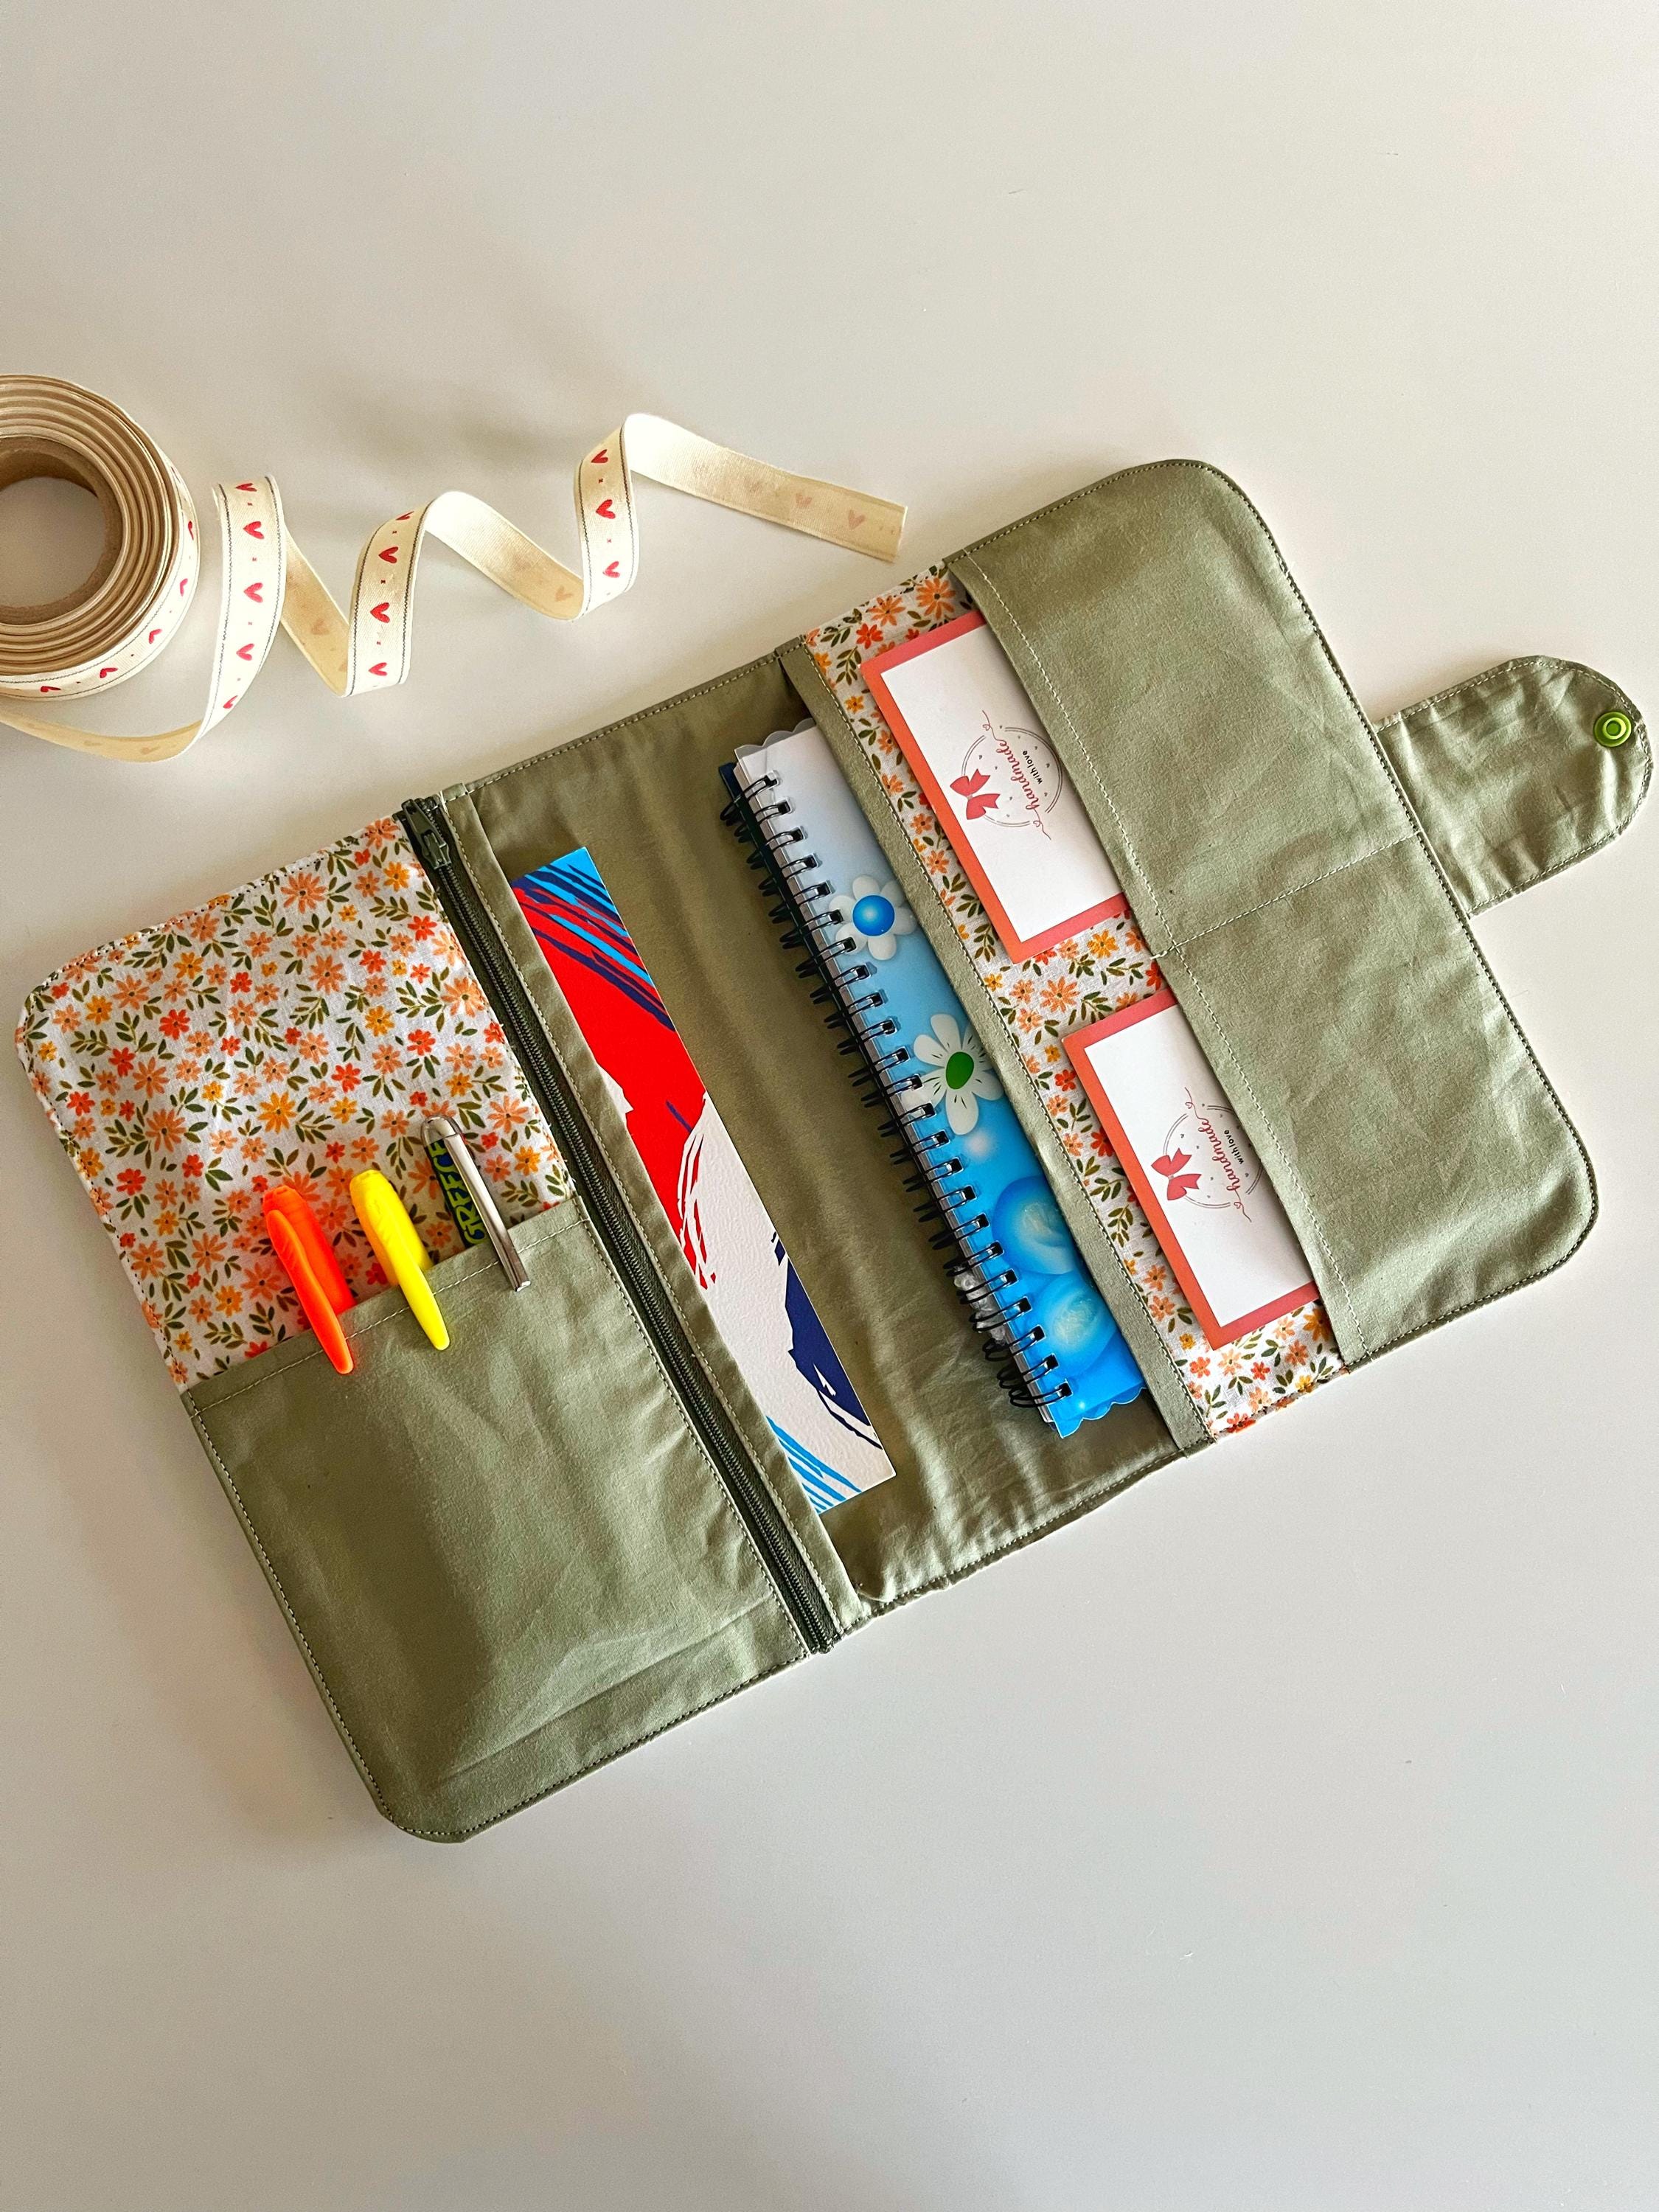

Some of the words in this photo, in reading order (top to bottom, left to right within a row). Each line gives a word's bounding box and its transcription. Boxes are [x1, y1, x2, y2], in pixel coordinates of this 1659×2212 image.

[1022, 750, 1034, 769] love
[995, 740, 1040, 810] handmade
[1029, 767, 1043, 785] with
[1224, 1129, 1236, 1148] love
[1197, 1119, 1241, 1192] handmade
[1231, 1147, 1245, 1165] with
